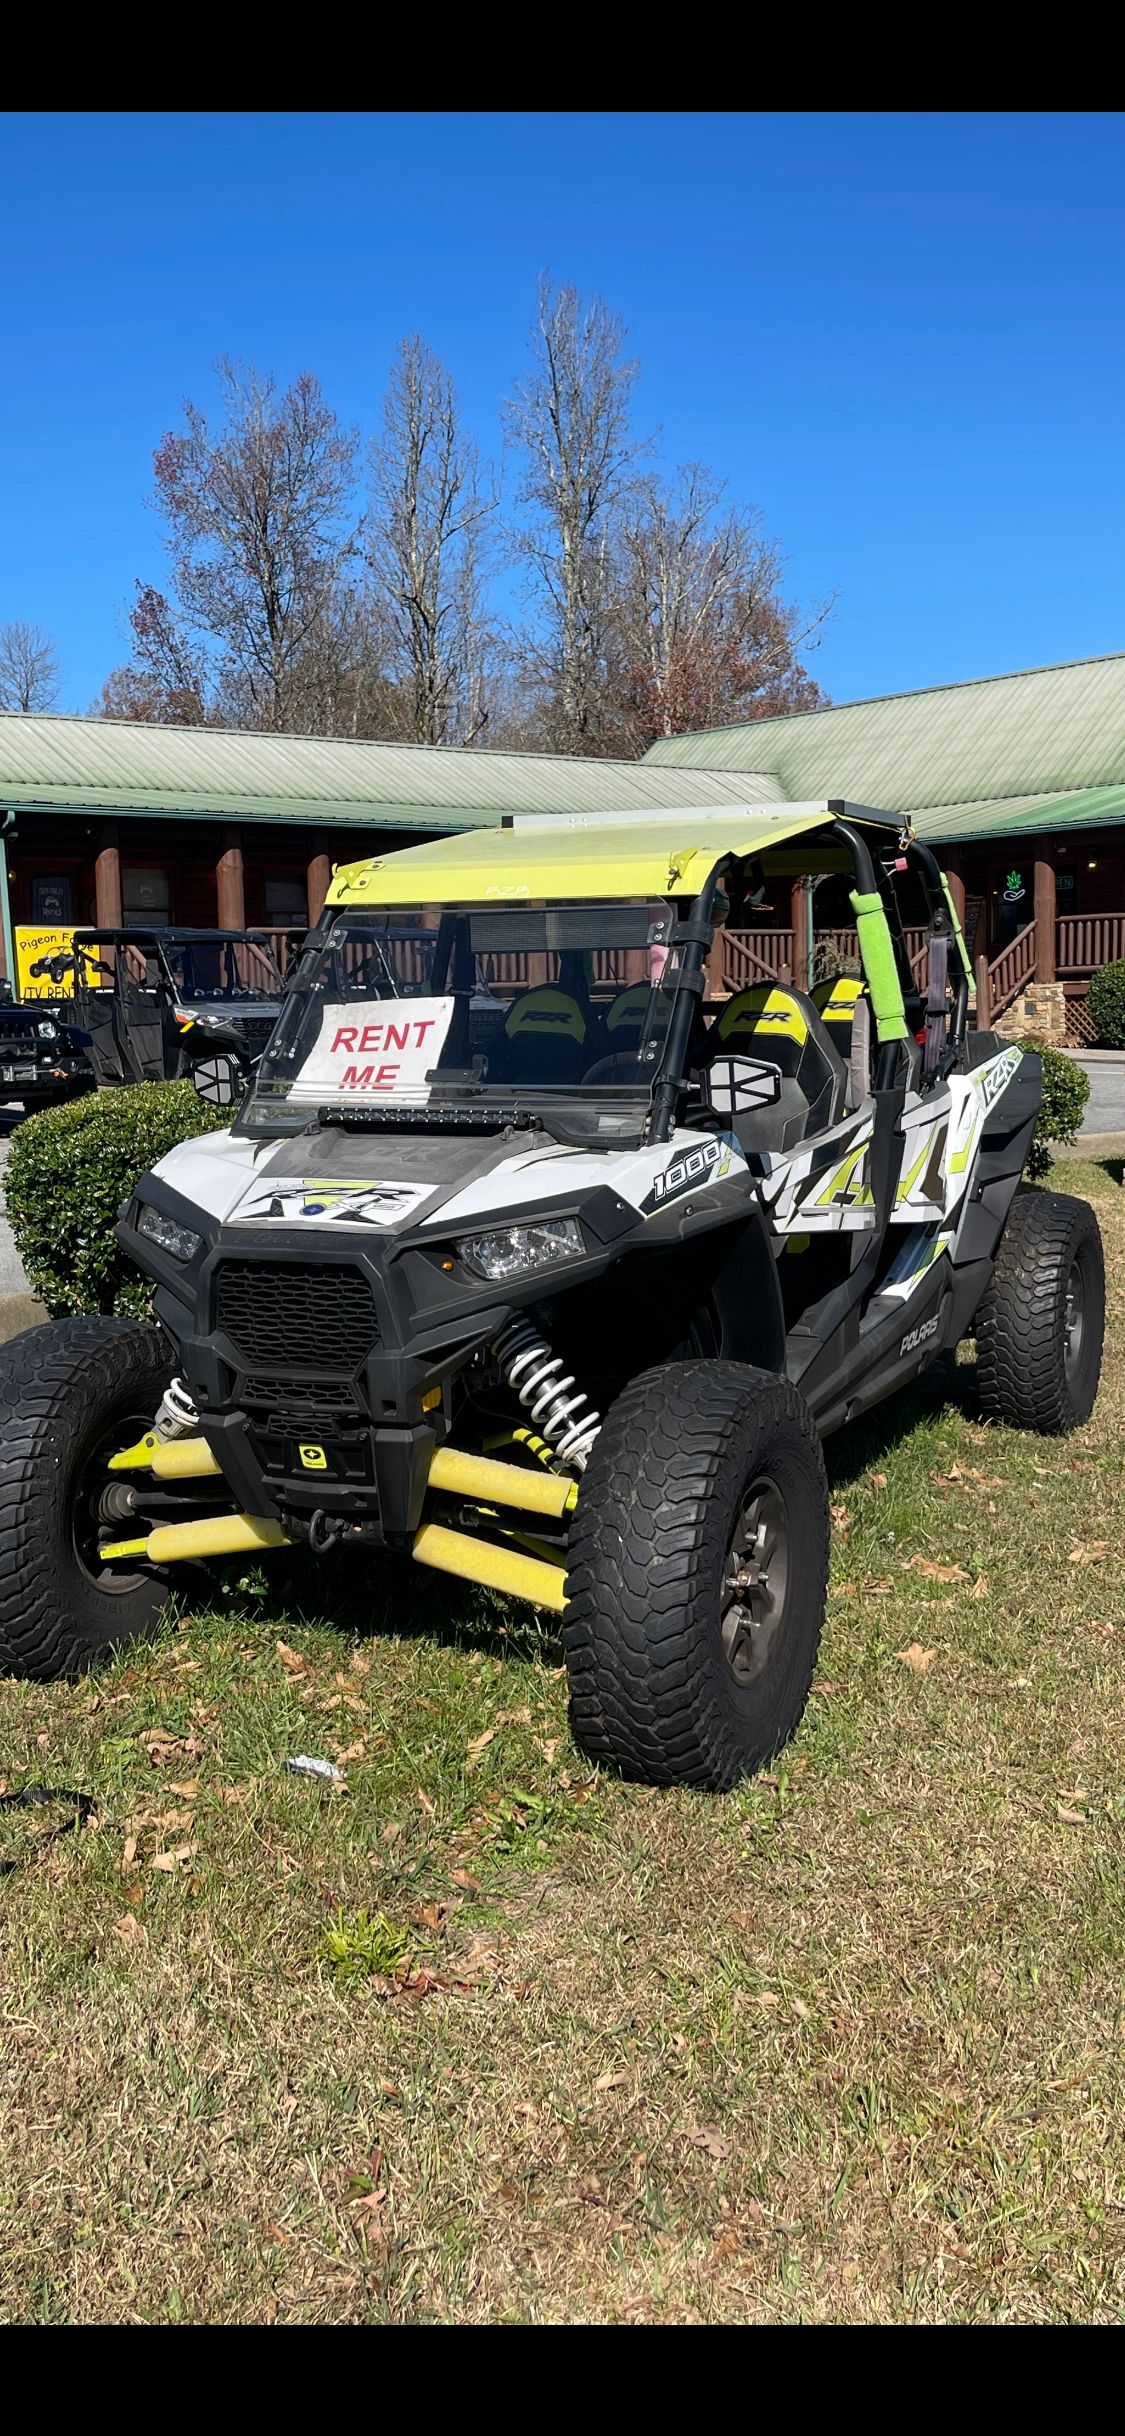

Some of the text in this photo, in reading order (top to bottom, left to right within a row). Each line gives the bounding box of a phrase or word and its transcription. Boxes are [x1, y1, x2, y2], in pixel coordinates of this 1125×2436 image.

[485, 885, 530, 897] RZR
[1056, 878, 1071, 888] PEN
[20, 934, 57, 951] Pigeon
[826, 1001, 856, 1010] RZ
[519, 1009, 573, 1024] RZR
[733, 1010, 791, 1023] RZR
[330, 1020, 436, 1053] RENT
[338, 1064, 401, 1090] ME
[982, 1054, 1016, 1107] RZR
[653, 1139, 722, 1201] 1000
[246, 1187, 421, 1205] RZR
[900, 1314, 939, 1357] POLARIS
